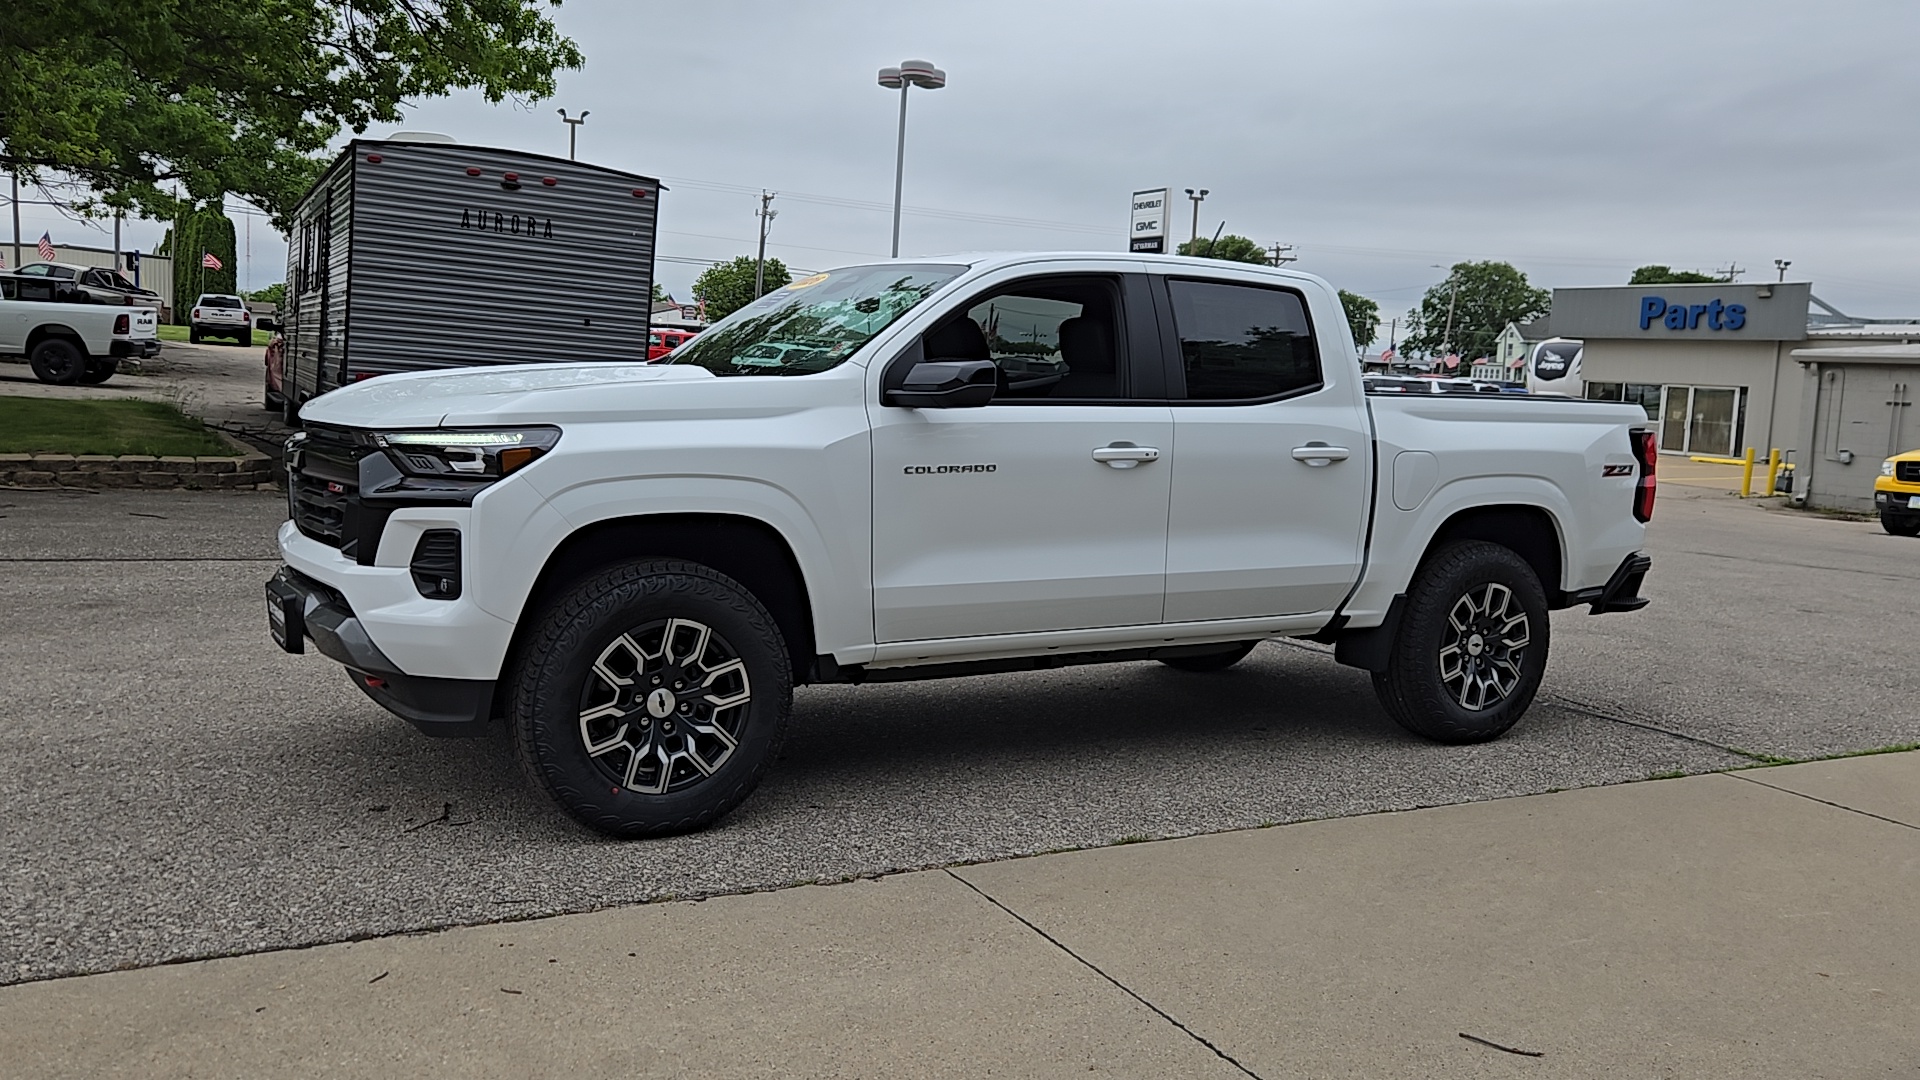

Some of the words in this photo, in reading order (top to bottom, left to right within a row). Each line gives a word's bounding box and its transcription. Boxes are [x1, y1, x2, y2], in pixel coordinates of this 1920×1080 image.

[1133, 199, 1162, 211] CHEVROLET
[460, 208, 553, 239] AURORA
[1135, 220, 1158, 232] GMC
[1639, 296, 1747, 331] Parts
[136, 318, 153, 326] RAM
[903, 464, 997, 475] COLORADO
[1601, 464, 1634, 478] Z71
